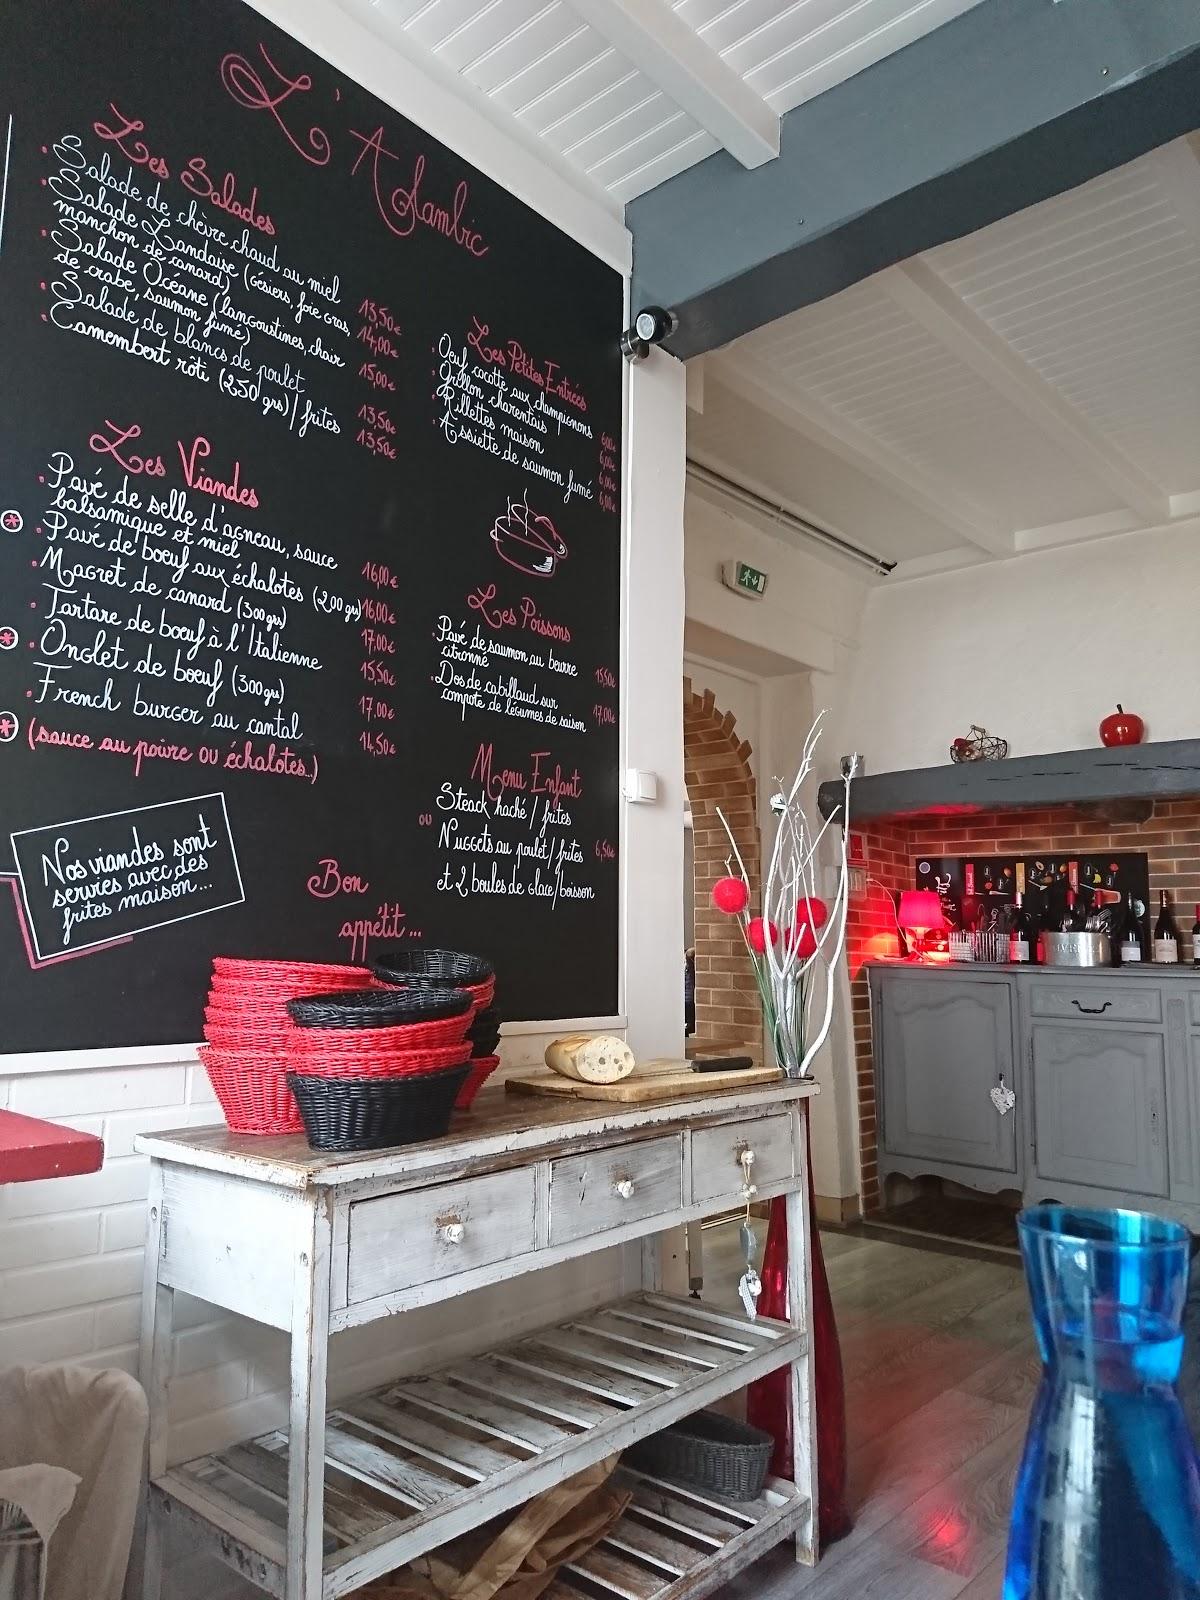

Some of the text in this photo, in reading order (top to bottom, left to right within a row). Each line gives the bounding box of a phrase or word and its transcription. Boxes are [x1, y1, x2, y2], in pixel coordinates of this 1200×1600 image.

[94, 103, 275, 235] Les Salades
[48, 169, 138, 228] Salade
[142, 215, 239, 277] Landaise
[297, 292, 322, 323] foie
[53, 136, 340, 303] Salade de chèvre chaud au miel
[53, 200, 230, 295] manchon de canard)
[51, 219, 137, 274] Salade
[143, 258, 208, 306] Océane
[308, 337, 345, 367] chair
[53, 250, 80, 269] de
[143, 287, 201, 321] saumon
[50, 302, 171, 365] Camembert
[175, 355, 209, 381] rôti
[51, 272, 305, 397] Salade de blancs de poulet
[357, 326, 398, 358] 14,00€
[358, 300, 401, 335] 13,50€
[359, 363, 396, 391] 15,00€
[467, 316, 587, 412] Les Petites Entrées
[471, 367, 508, 392] cocotte
[510, 386, 535, 412] aux
[357, 404, 396, 434] 13,50€
[443, 386, 544, 454] Rillettes maison
[488, 390, 547, 434] charentais
[89, 420, 258, 508] Les Viandes
[356, 429, 397, 459] 13,50€
[439, 410, 594, 504] Assiette de saumon fumé
[48, 452, 107, 497] Pavé
[112, 475, 142, 509] de
[147, 489, 197, 525] selle
[293, 544, 338, 569] sauce
[50, 487, 240, 558] balsamique et miel
[43, 511, 105, 547] Pavé
[108, 529, 136, 555] de
[192, 563, 230, 588] aux
[231, 562, 304, 602] échalotes
[42, 583, 122, 626] Tartare
[124, 604, 155, 634] de
[207, 626, 223, 649] à
[129, 566, 162, 595] de
[165, 587, 232, 613] canard
[467, 584, 571, 643] Les Poissons
[133, 643, 166, 676] de
[437, 615, 578, 677] Pavé de saumon au beurre
[441, 644, 490, 669] citronné
[33, 662, 121, 711] French
[211, 713, 239, 730] au
[245, 708, 303, 740] cantal
[435, 660, 559, 711] Dos de cabillaud sur
[440, 688, 486, 722] compote
[487, 696, 502, 713] de
[544, 710, 558, 726] de
[559, 714, 587, 733] saison
[28, 717, 94, 750] (sauce
[99, 737, 130, 754] au
[133, 739, 193, 777] poivre
[471, 744, 582, 809] Menu Enfant
[436, 782, 491, 819] Steack
[494, 795, 527, 820] haché
[540, 799, 572, 838] frites
[42, 814, 217, 886] Nos viandes sont
[495, 840, 512, 854] au
[53, 853, 208, 909] servies avec des
[306, 859, 369, 898] Bon
[437, 862, 453, 891] et
[455, 866, 468, 897] 2
[472, 861, 506, 894] boules
[508, 865, 524, 895] de
[62, 902, 112, 945] frites
